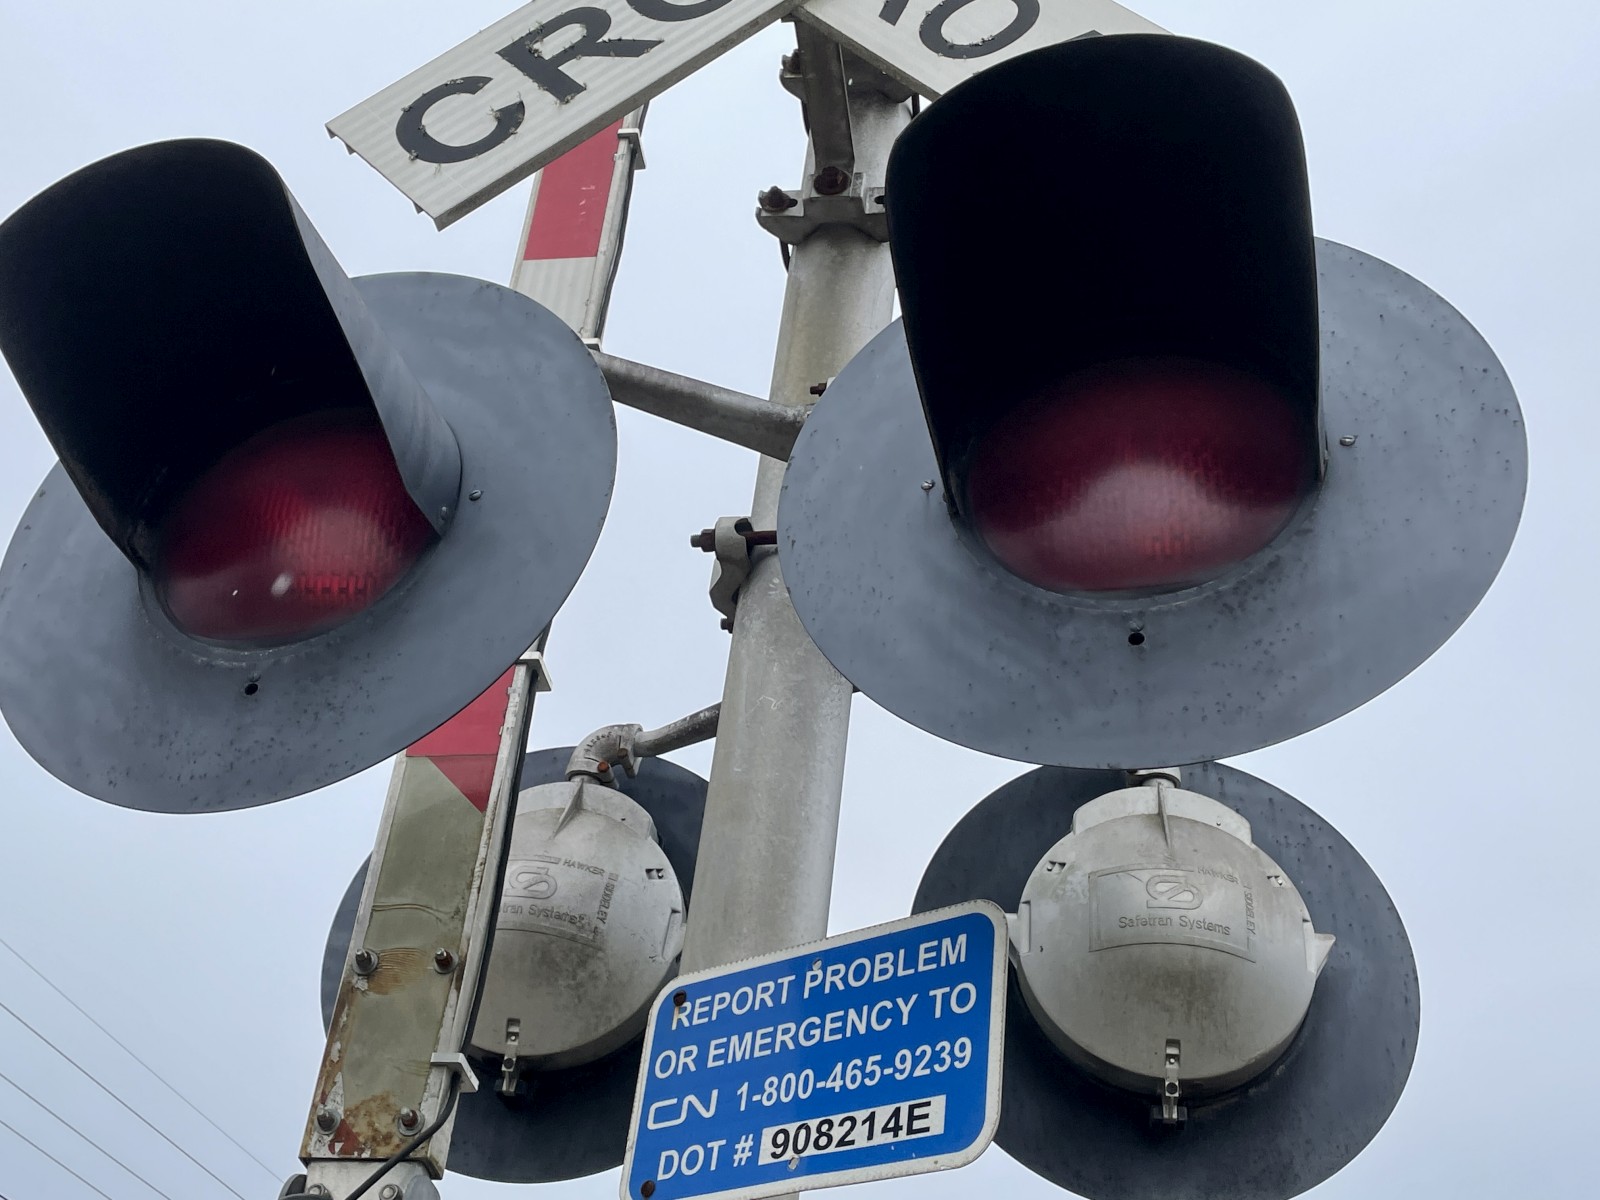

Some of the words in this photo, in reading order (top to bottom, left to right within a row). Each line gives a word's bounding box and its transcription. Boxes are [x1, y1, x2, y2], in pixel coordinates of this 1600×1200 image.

[396, 0, 737, 164] CR
[563, 859, 606, 877] HAWKER
[1118, 915, 1173, 929] Safetran
[1179, 915, 1231, 935] Systems
[671, 974, 796, 1031] REPORT
[803, 933, 967, 999] PROBLEM
[655, 1044, 698, 1079] OR
[707, 993, 919, 1068] EMERGENCY
[928, 982, 977, 1019] TO
[736, 1036, 972, 1112] 1-800-465-9239
[657, 1138, 727, 1181] DOT
[733, 1133, 755, 1167] #
[770, 1100, 932, 1160] 908214E
